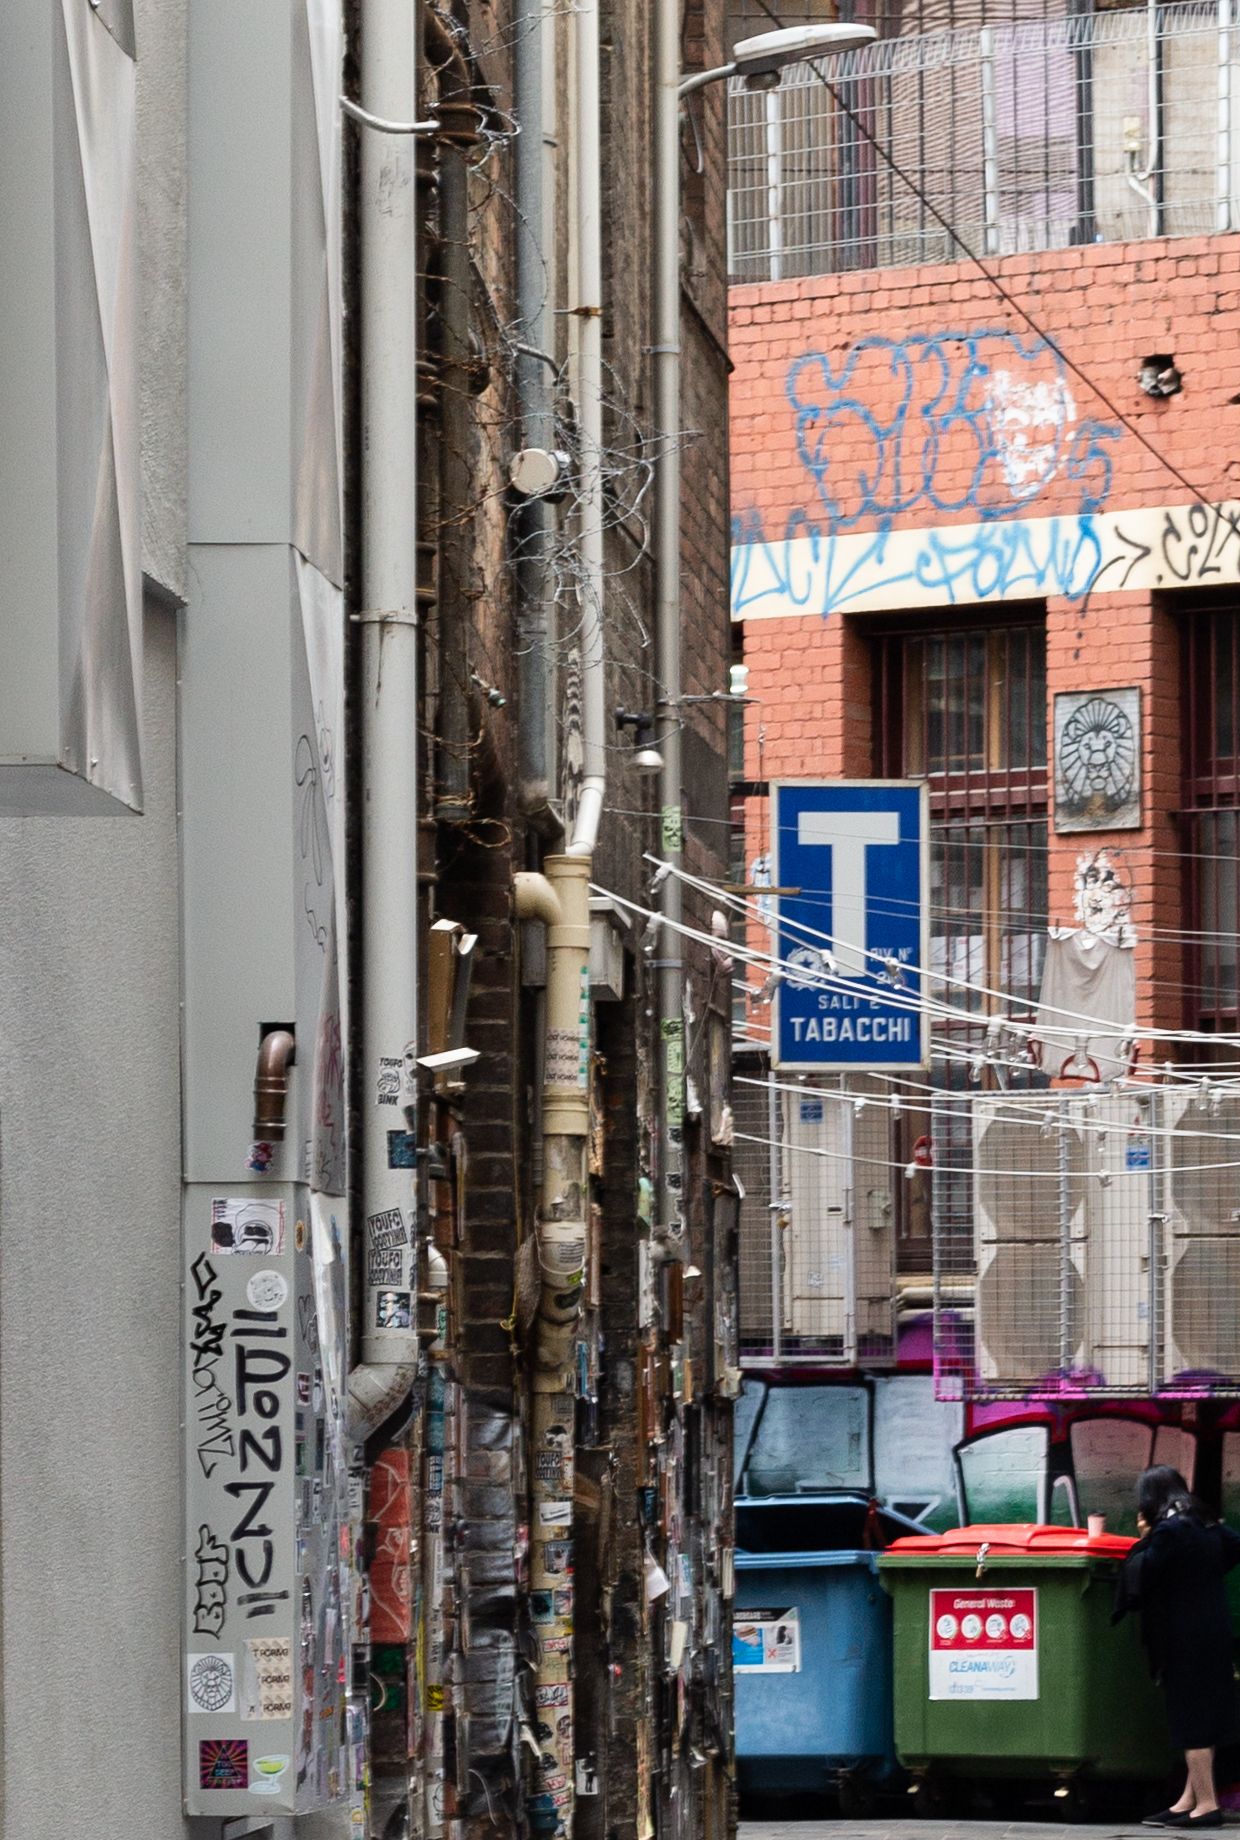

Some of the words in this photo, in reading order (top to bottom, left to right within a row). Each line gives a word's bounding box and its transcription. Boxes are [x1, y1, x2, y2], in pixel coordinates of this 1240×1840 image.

[797, 811, 900, 977] T
[818, 995, 860, 1010] SALI
[869, 995, 881, 1010] E
[789, 1017, 911, 1042] TABACCHI
[953, 1598, 985, 1609] General
[949, 1661, 1012, 1673] CLEANAWAY
